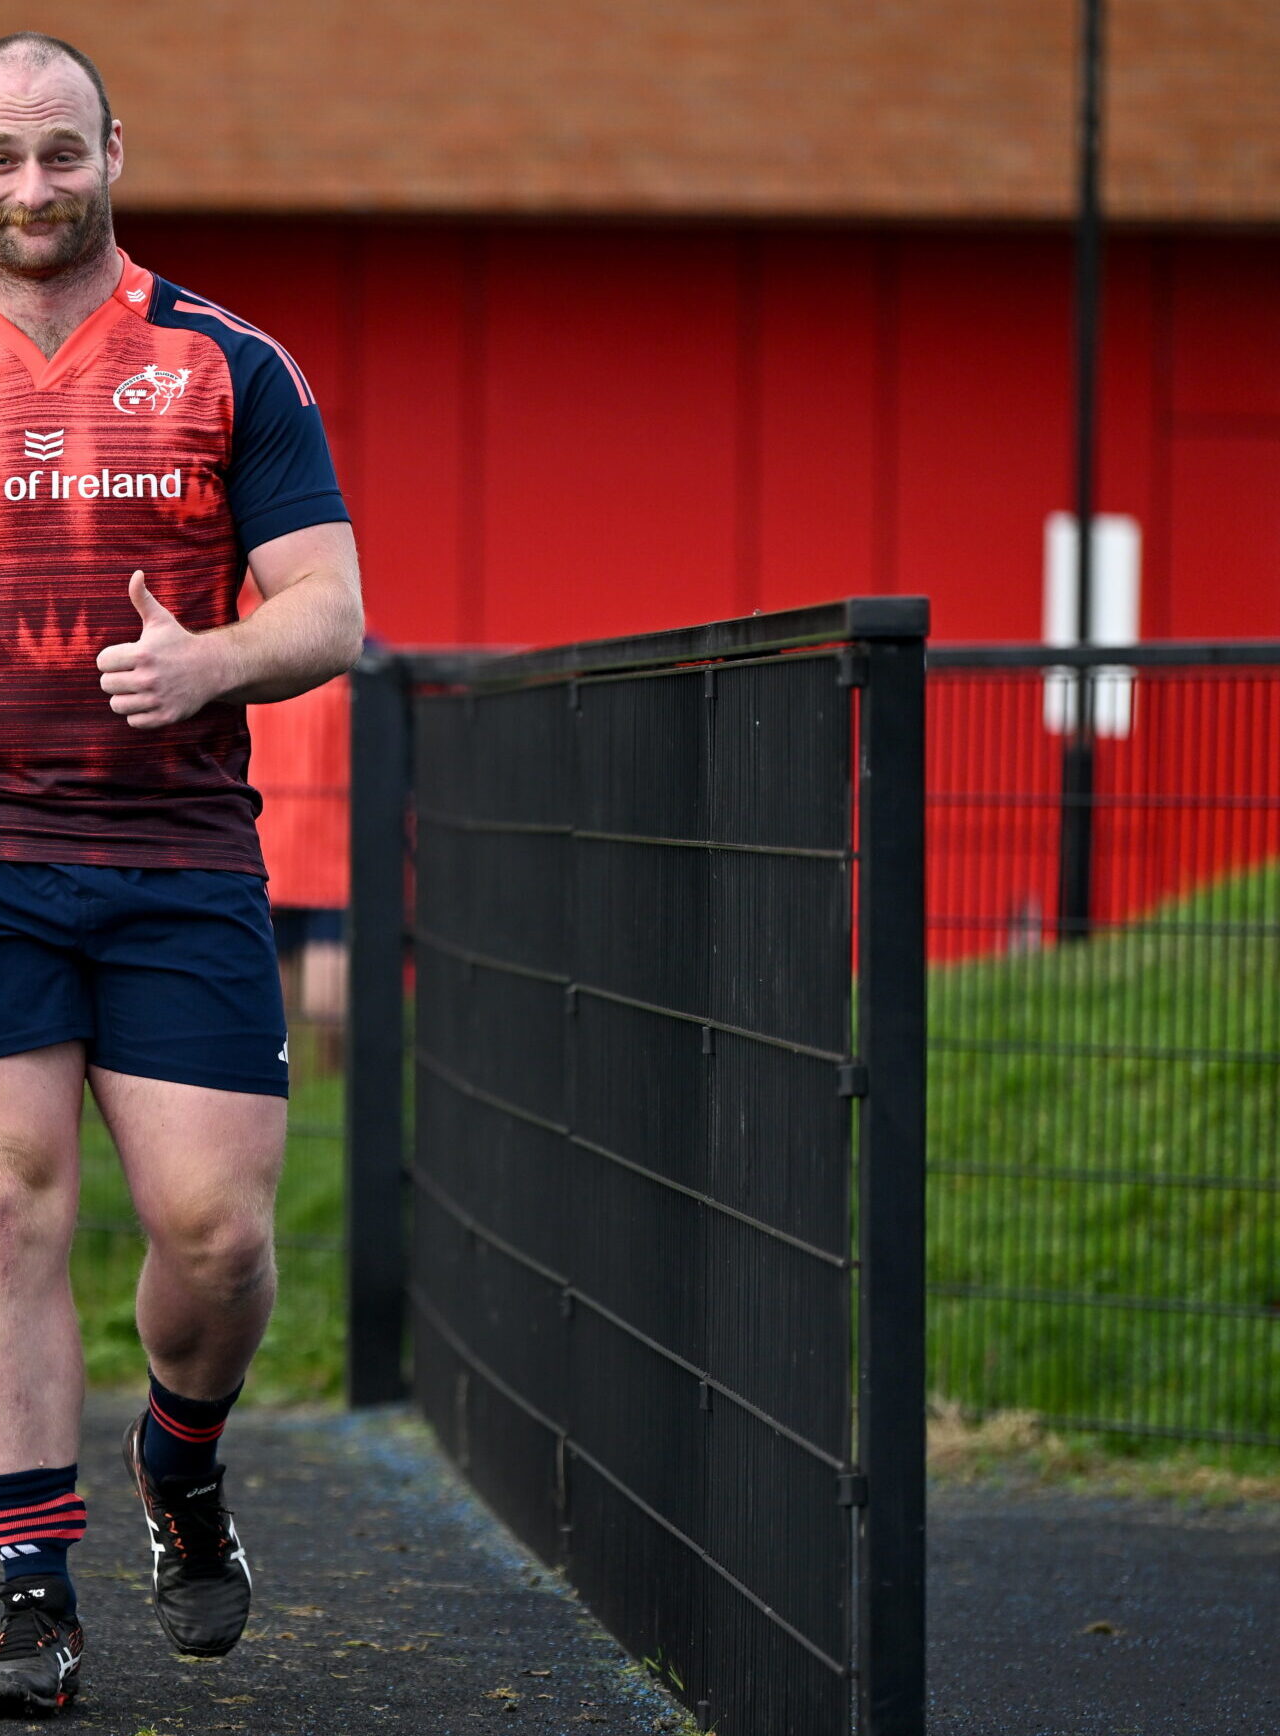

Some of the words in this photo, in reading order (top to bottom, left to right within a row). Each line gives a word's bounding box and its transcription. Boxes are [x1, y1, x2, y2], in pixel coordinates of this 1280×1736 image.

[116, 374, 145, 395] MUNSTER
[4, 470, 44, 501] of
[51, 468, 182, 500] Ireland
